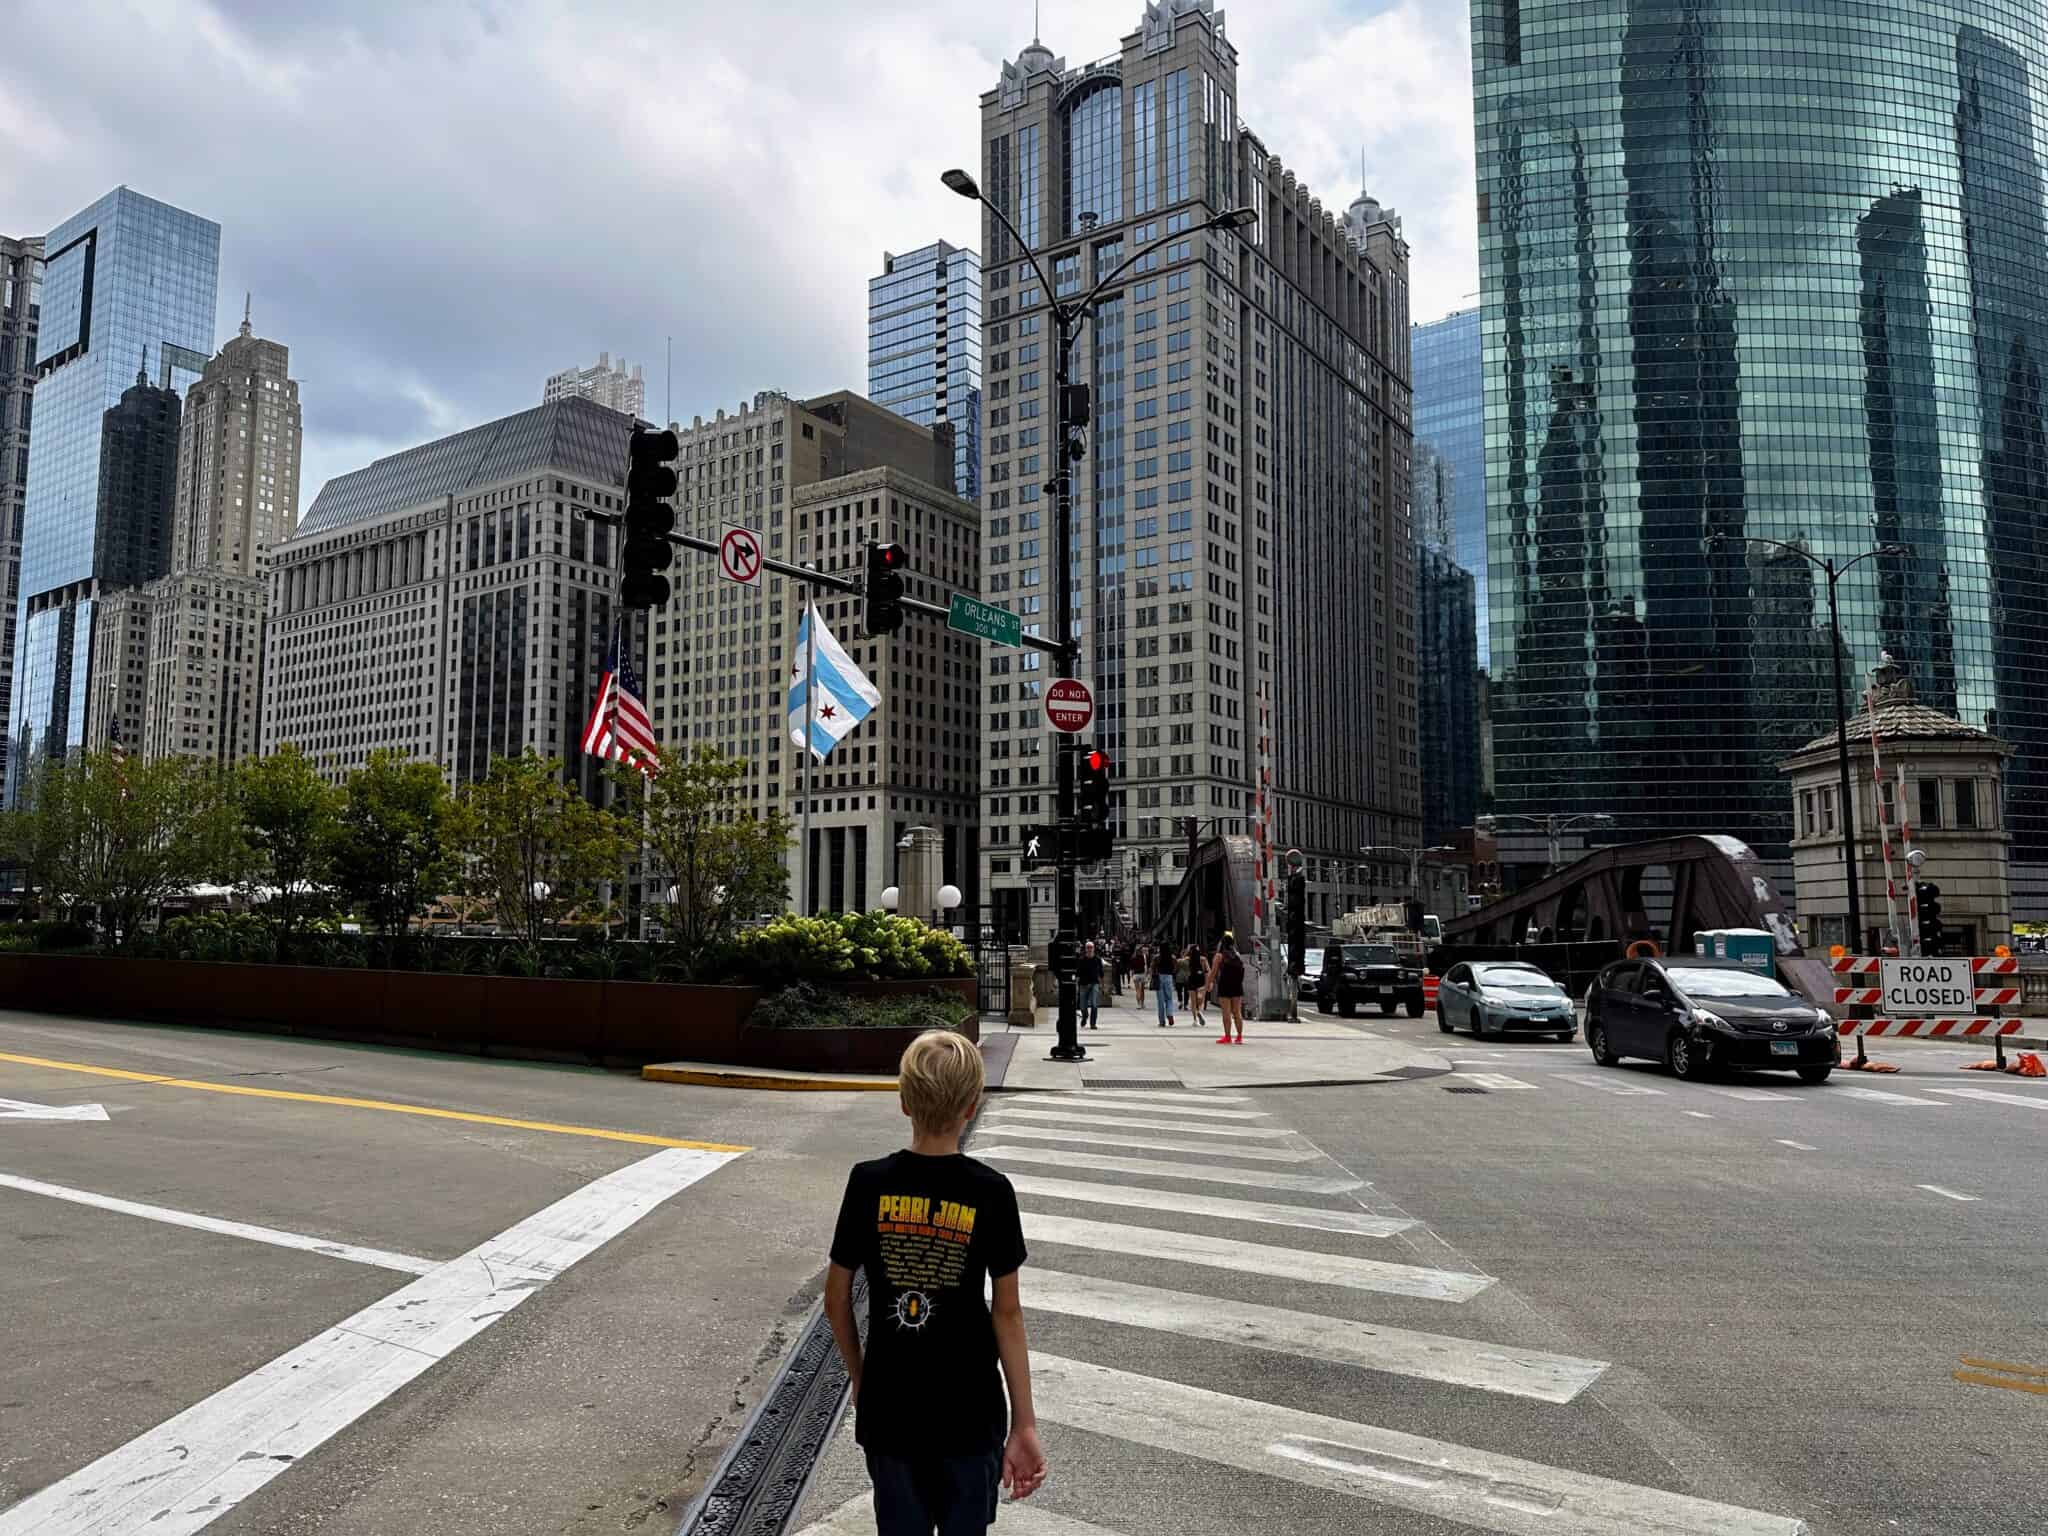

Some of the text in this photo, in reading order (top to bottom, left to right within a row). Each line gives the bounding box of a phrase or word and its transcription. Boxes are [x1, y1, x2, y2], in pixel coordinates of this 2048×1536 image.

[964, 602, 1006, 628] ORLEANS
[1052, 688, 1087, 699] DO NOT
[1056, 712, 1083, 722] ENTER
[1900, 966, 1953, 983] ROAD
[1891, 988, 1965, 1005] CLOSED
[878, 1195, 930, 1224] PEARL
[933, 1200, 977, 1234] JAM
